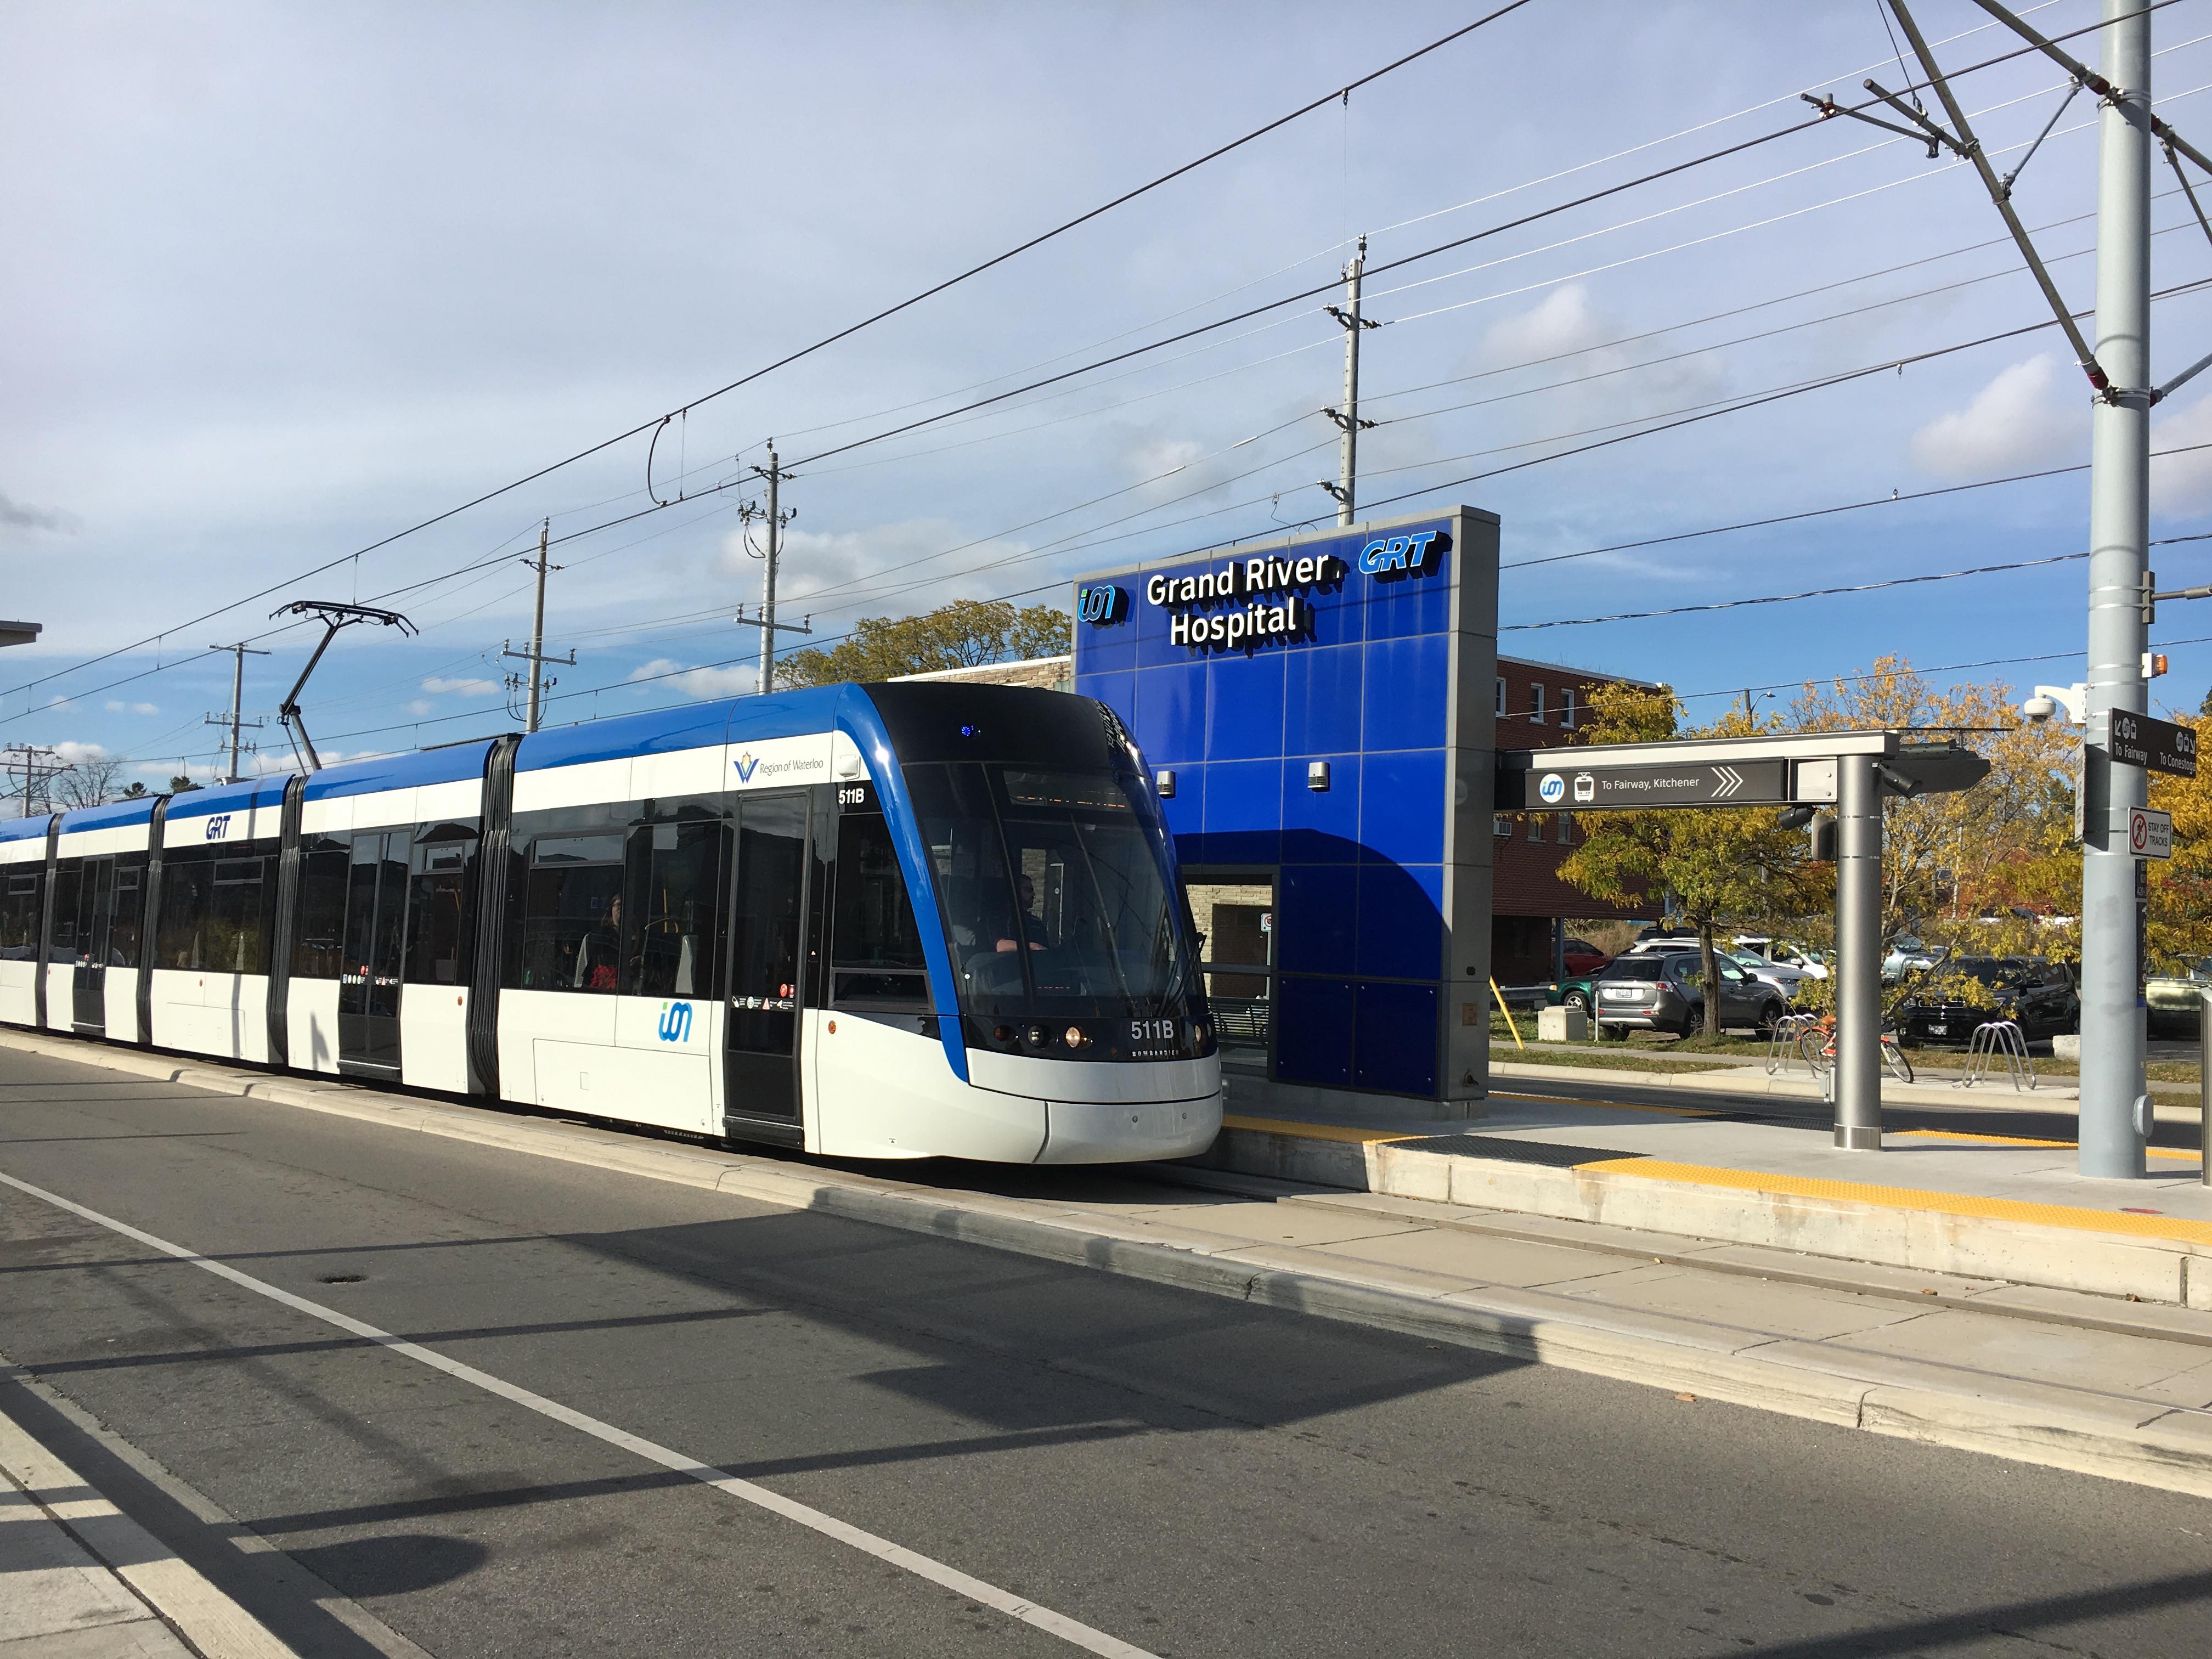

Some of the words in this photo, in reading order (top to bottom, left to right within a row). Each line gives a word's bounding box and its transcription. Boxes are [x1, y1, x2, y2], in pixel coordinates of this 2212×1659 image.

[1358, 530, 1437, 574] GRT
[1147, 561, 1233, 605] Grand
[1246, 555, 1329, 591] River
[1171, 596, 1296, 648] Hospital
[2115, 742, 2122, 756] To
[2124, 744, 2148, 765] Fairway
[2160, 752, 2166, 765] To
[2168, 754, 2196, 775] Conestoga
[760, 763, 783, 776] Region
[783, 761, 791, 771] of
[793, 758, 823, 771] Waterloo
[1601, 781, 1612, 790] To
[1614, 780, 1651, 791] Fairway,
[1654, 777, 1700, 788] Kitchener
[839, 788, 865, 804] 511B
[206, 815, 231, 840] GRT
[2148, 822, 2159, 832] STAY
[2160, 823, 2169, 833] OFF
[2149, 835, 2168, 847] TRACKS
[1131, 1020, 1174, 1040] 511B
